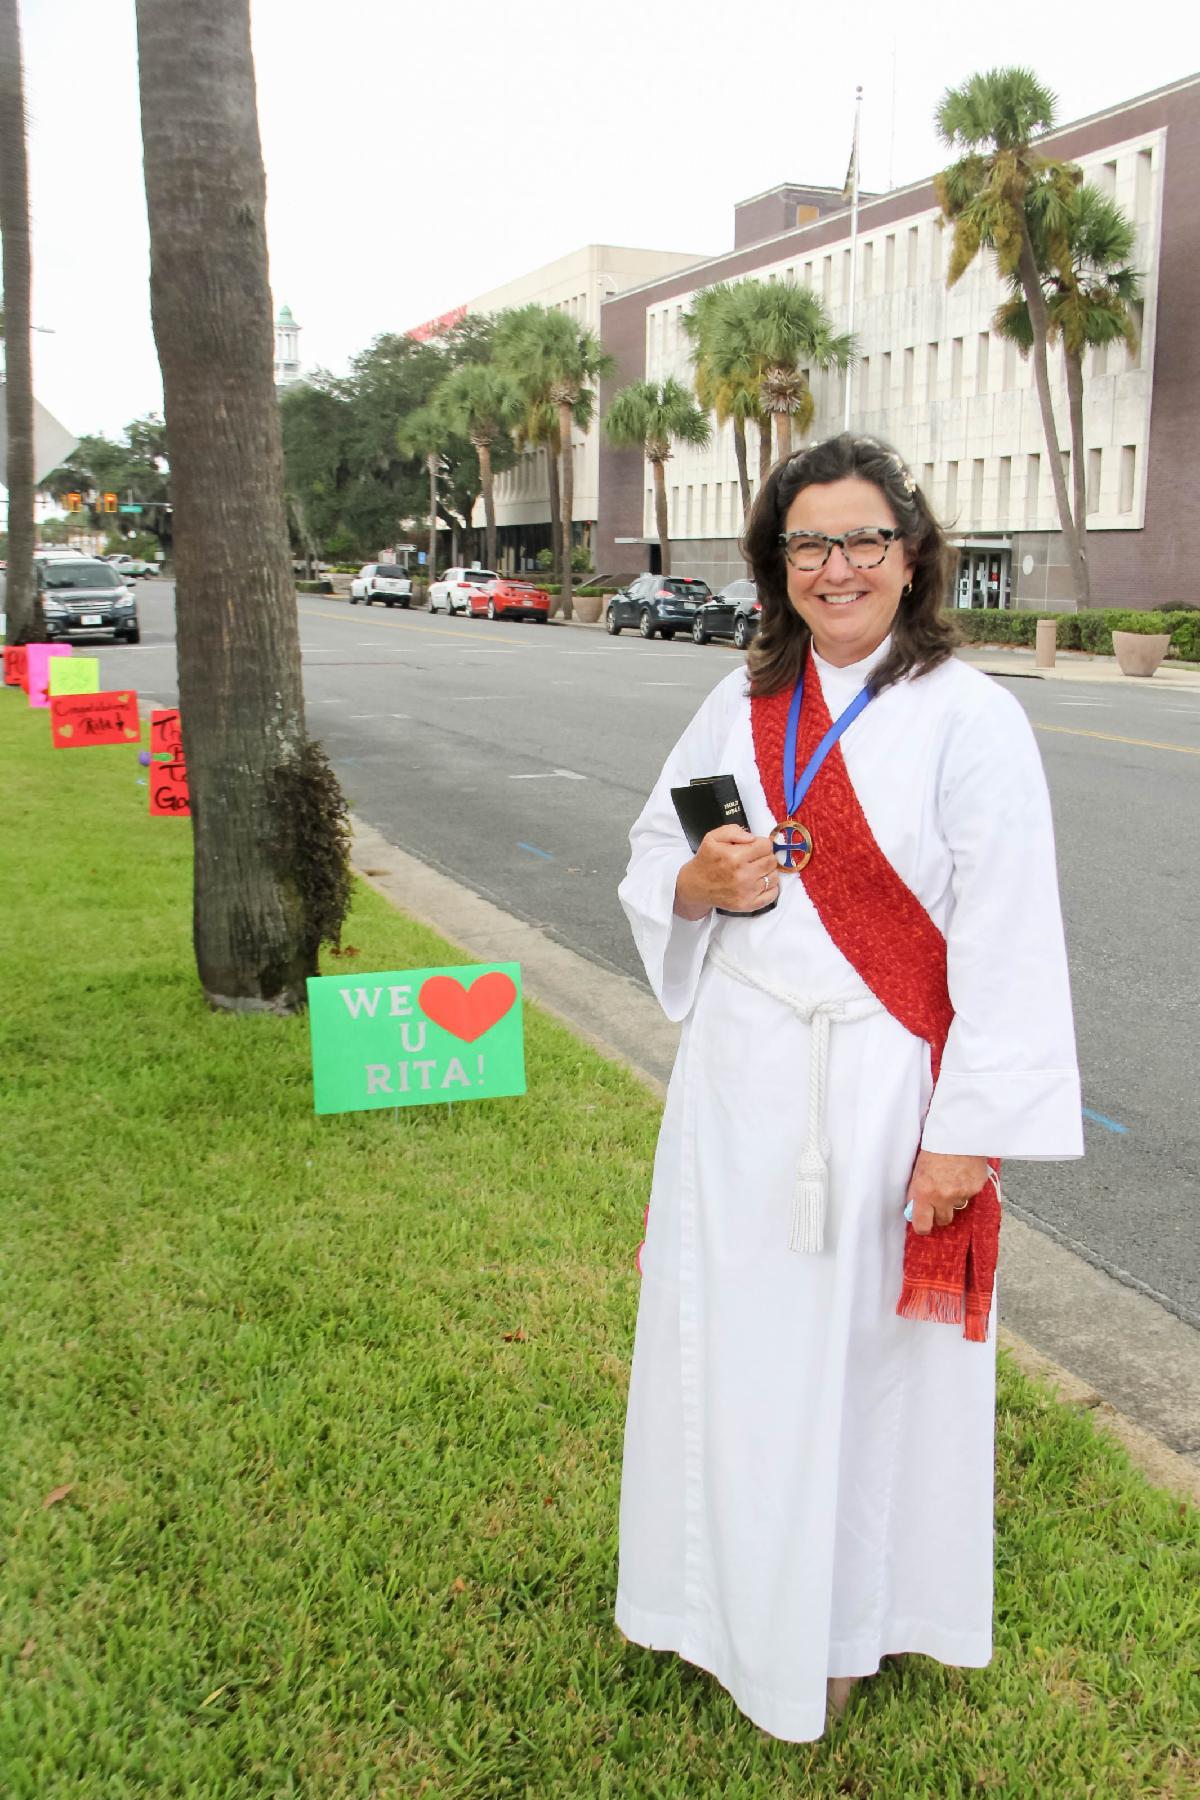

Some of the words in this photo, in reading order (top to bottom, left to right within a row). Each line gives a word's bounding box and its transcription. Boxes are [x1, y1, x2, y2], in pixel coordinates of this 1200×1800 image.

[154, 786, 190, 811] Go
[339, 985, 414, 1019] WE
[400, 1021, 428, 1053] U
[365, 1054, 485, 1095] RITA!
